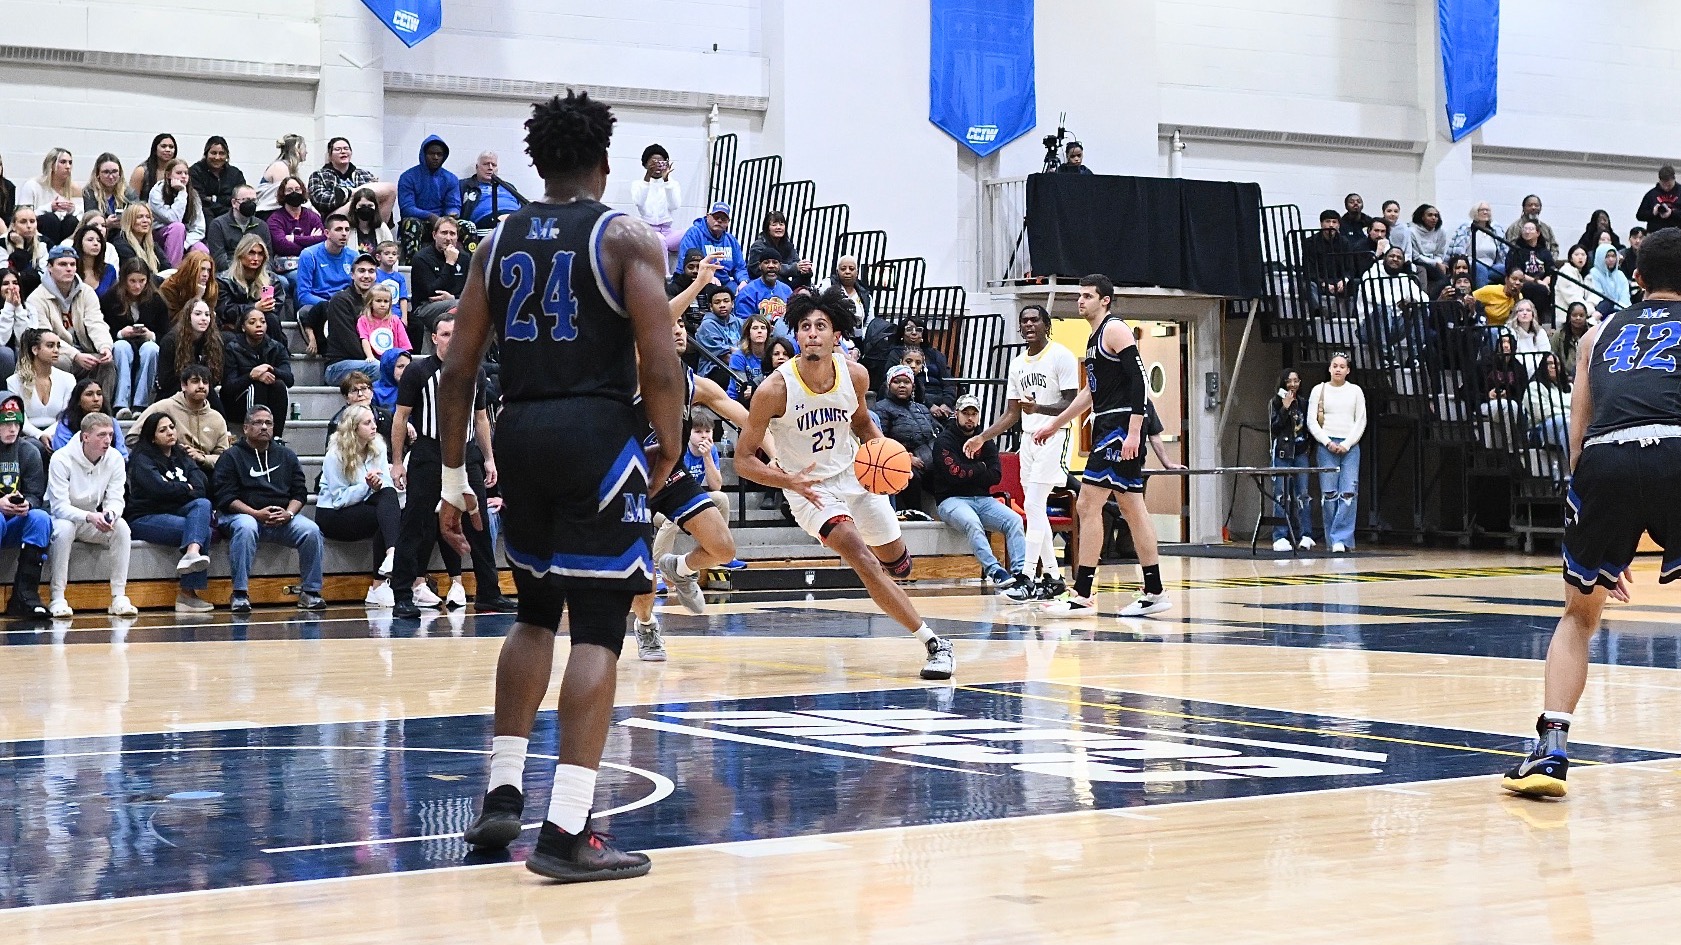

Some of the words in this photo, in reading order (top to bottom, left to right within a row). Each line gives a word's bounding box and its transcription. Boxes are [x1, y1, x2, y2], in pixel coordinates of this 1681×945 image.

[393, 10, 420, 32] CCIW
[966, 126, 999, 141] CCIW
[500, 250, 578, 341] 24
[1603, 320, 1681, 373] 42
[1020, 372, 1047, 391] VIKINGS
[797, 407, 849, 431] VIKINGS
[812, 427, 836, 453] 23
